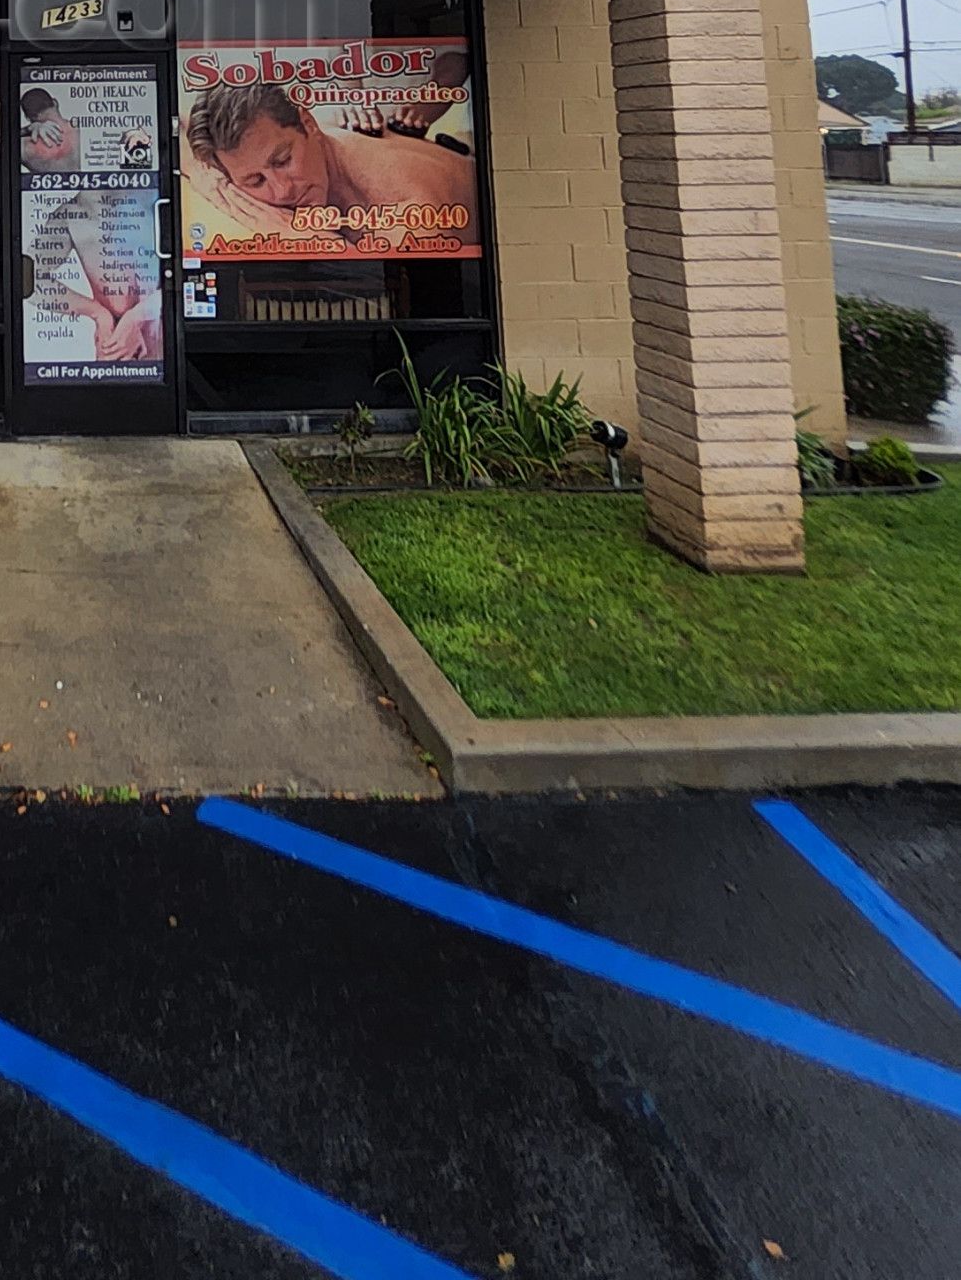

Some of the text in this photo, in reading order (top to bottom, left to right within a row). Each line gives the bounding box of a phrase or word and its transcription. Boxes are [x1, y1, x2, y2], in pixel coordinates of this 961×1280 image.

[46, 0, 102, 26] 14233
[184, 40, 435, 91] Sobador
[30, 69, 148, 82] Call For Appointment
[70, 85, 146, 98] BODY HEALING
[288, 82, 469, 108] Quiropractico
[88, 100, 129, 112] CENTER
[70, 115, 153, 128] CHIROPRACTOR
[30, 173, 151, 189] 562-945-6040
[292, 205, 469, 231] 562-945-6040
[206, 234, 347, 255] Accidentes
[357, 233, 390, 254] de
[397, 233, 462, 253] Auto
[37, 366, 158, 379] Call For Appointment
